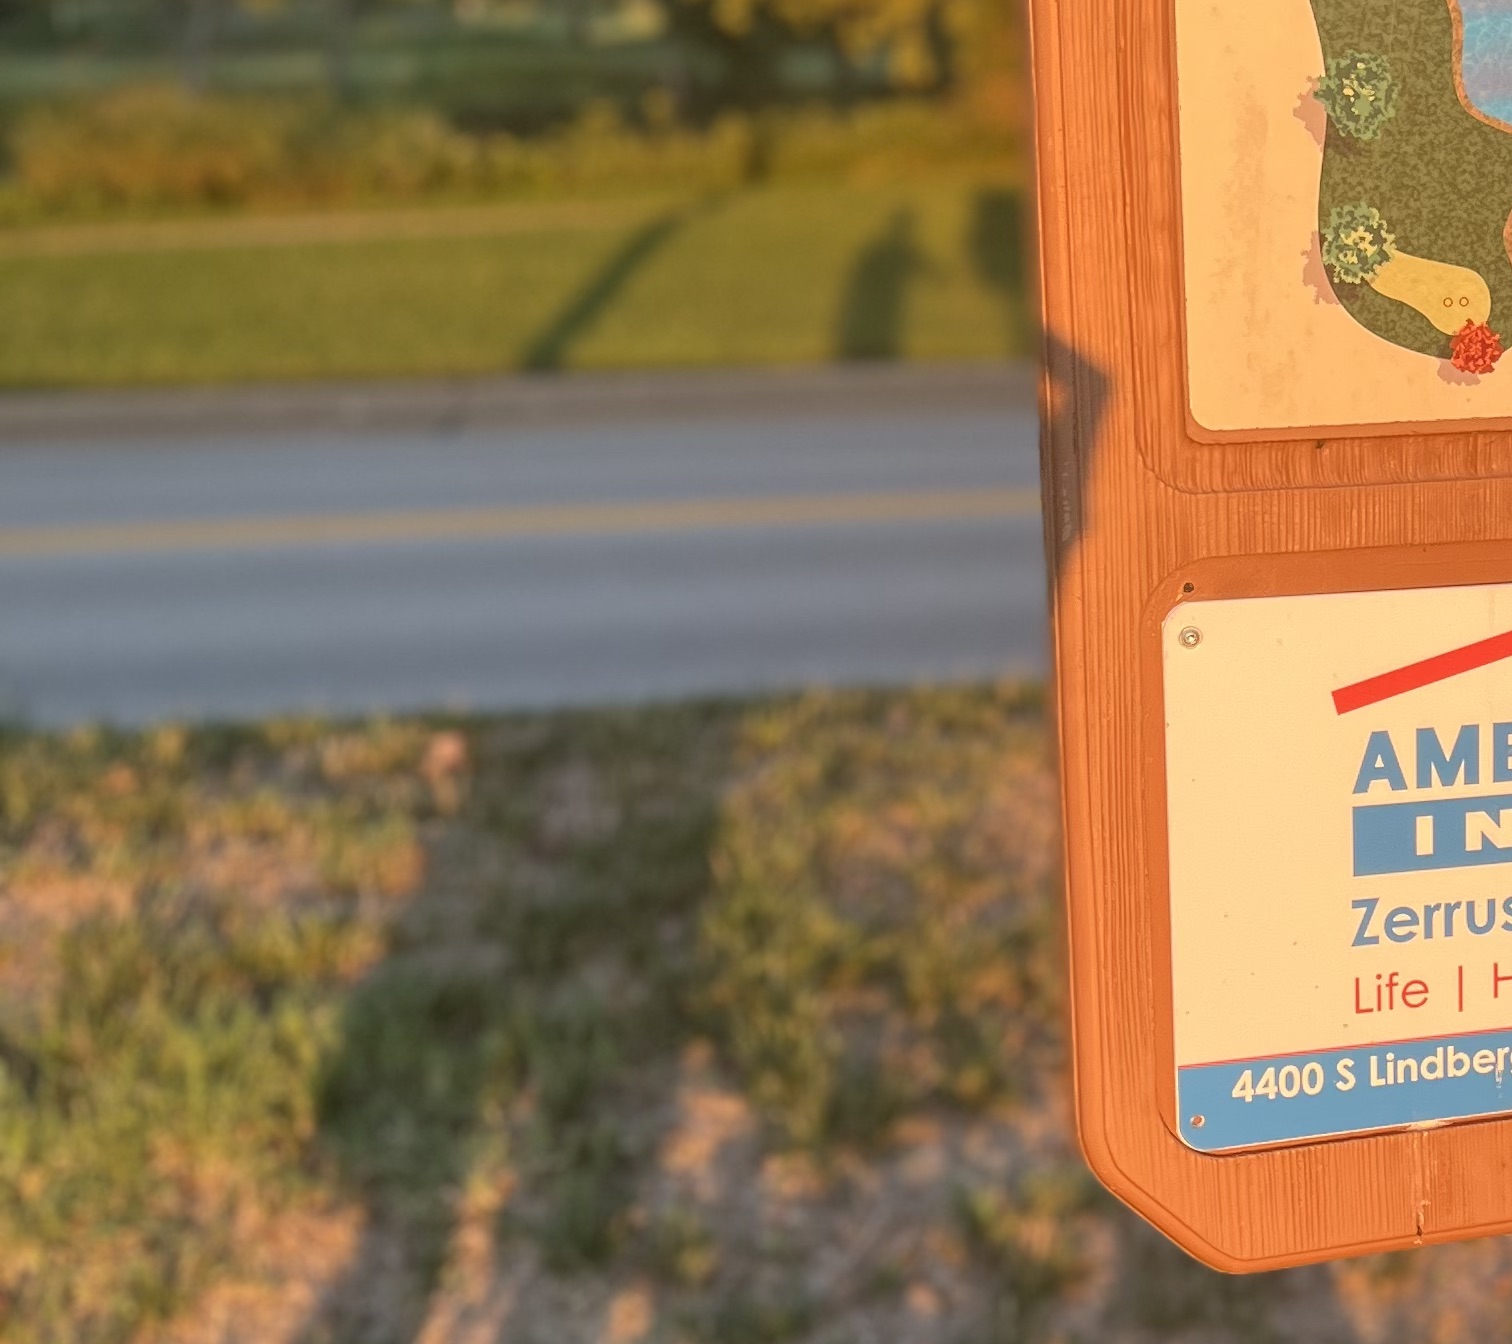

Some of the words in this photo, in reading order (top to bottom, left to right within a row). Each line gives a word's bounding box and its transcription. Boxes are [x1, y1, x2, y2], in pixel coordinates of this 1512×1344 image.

[1354, 971, 1430, 1014] Life
[1231, 1062, 1325, 1102] 4400
[1336, 1058, 1356, 1091] S
